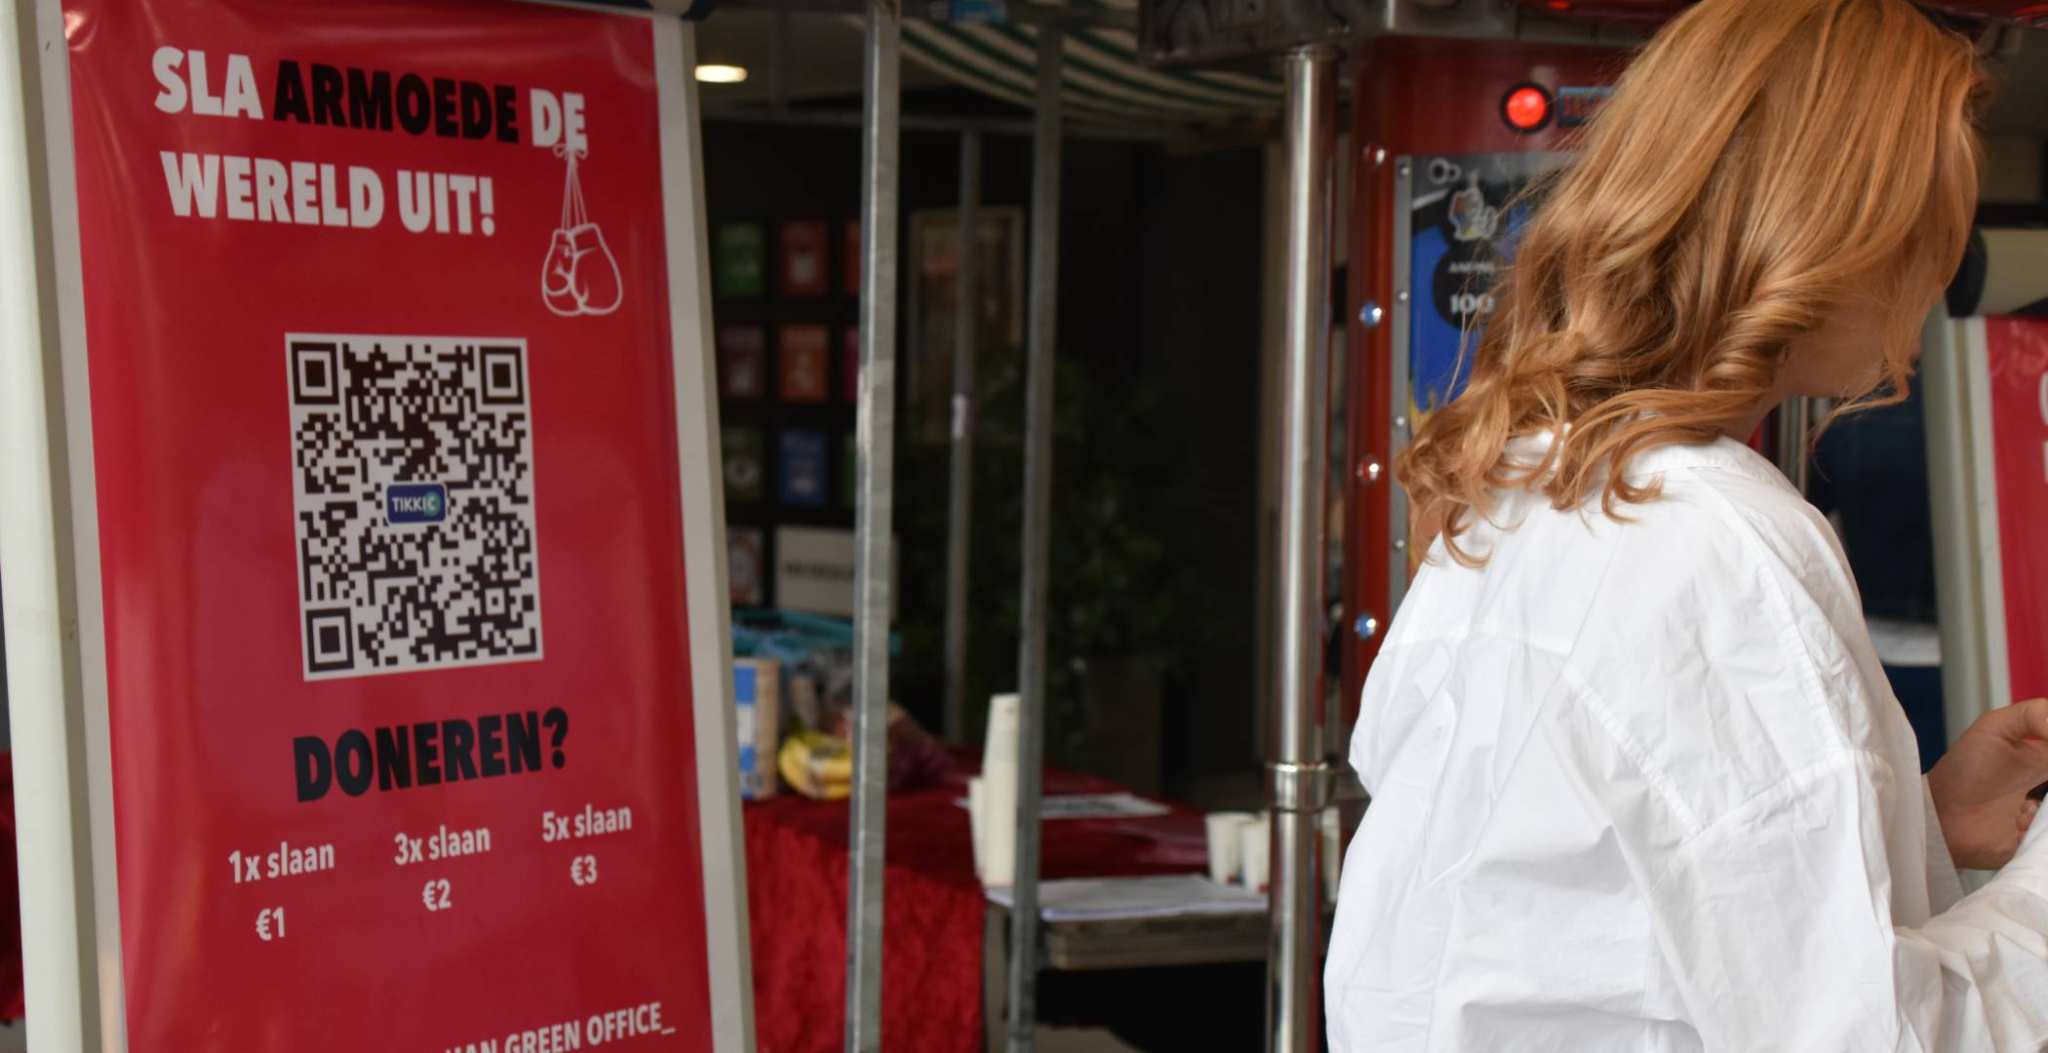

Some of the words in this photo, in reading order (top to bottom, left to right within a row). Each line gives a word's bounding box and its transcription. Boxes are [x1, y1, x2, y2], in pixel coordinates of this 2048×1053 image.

[152, 46, 264, 120] SLA
[273, 60, 520, 144] ARMOEDE
[529, 87, 588, 152] DE
[160, 150, 385, 229] WERELD
[396, 169, 496, 237] UIT!
[293, 706, 569, 803] DONEREN?
[541, 810, 570, 842] 5x
[574, 803, 633, 838] slaan
[228, 850, 262, 883] 1x
[267, 841, 335, 878] slaan
[394, 832, 424, 866] 3x
[429, 824, 491, 861] slaan
[570, 855, 598, 886] €3
[422, 878, 452, 912] €2
[256, 906, 286, 941] €1
[504, 1020, 580, 1053] GREEN
